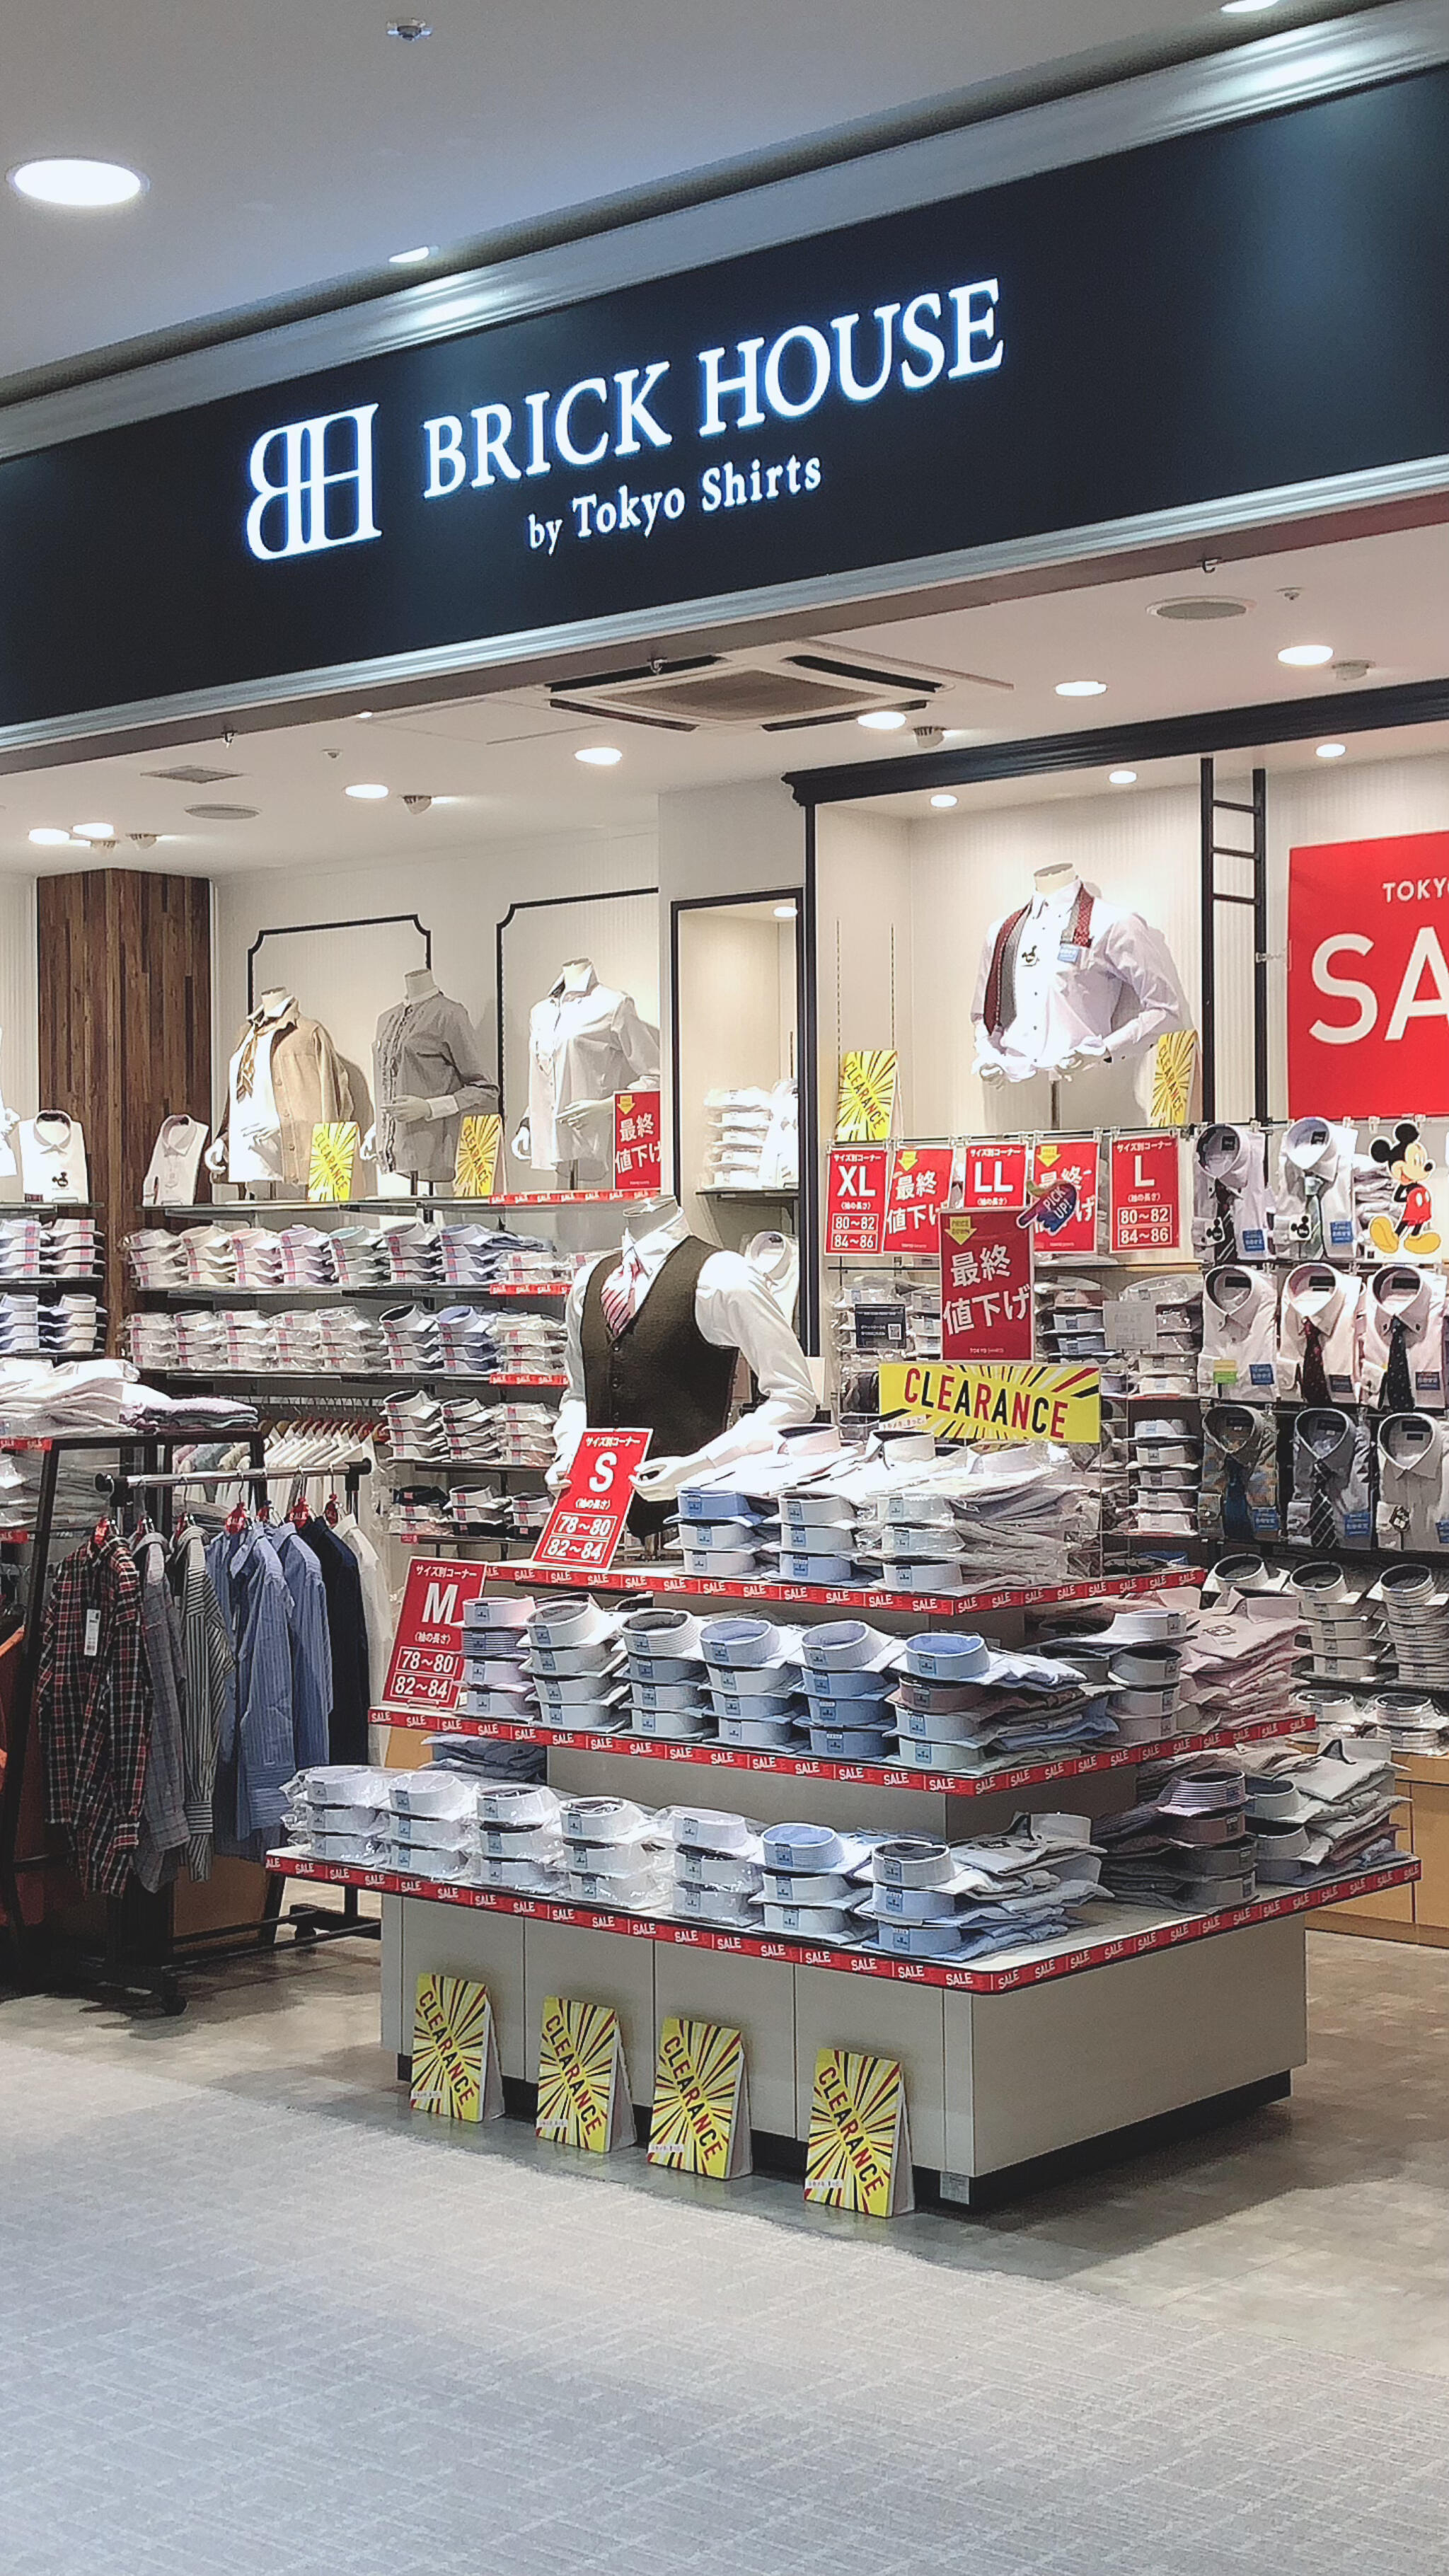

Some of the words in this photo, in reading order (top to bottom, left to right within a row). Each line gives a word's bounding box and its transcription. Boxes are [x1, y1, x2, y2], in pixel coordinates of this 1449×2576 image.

[423, 359, 672, 499] BRICK
[699, 277, 1005, 438] HOUSE
[527, 513, 562, 555] by
[572, 487, 686, 538] Tokyo
[702, 456, 821, 512] Shirts
[1382, 876, 1449, 903] TOKY
[843, 1061, 887, 1131] CLEARANCE
[1157, 1043, 1183, 1119] CLEARANCE
[462, 1124, 488, 1186] CLEARANCE
[620, 1112, 654, 1142] 最終
[313, 1132, 349, 1192] CLEARANCE
[837, 1165, 876, 1196] XL
[895, 1170, 937, 1200] 最終
[974, 1160, 1013, 1193] LL
[1135, 1155, 1155, 1187] L
[1042, 1185, 1067, 1211] PICK
[1053, 1199, 1073, 1220] UP!
[950, 1244, 1011, 1288] 最終
[942, 1283, 1031, 1336] 値下げ
[904, 1366, 1068, 1439] CLEARANCE
[589, 1451, 618, 1493] S
[416, 1564, 478, 1579] サイズ別コーナー
[487, 1566, 499, 1576] LE
[514, 1569, 534, 1581] SALE
[551, 1571, 572, 1583] SALE
[588, 1574, 608, 1585] SALE
[625, 1576, 647, 1588] SALE
[664, 1579, 686, 1590] SALE
[703, 1581, 724, 1594] SALE
[744, 1584, 766, 1597] SALE
[784, 1587, 807, 1600] SALE
[826, 1590, 850, 1603] SALE
[868, 1594, 893, 1607] SALE
[912, 1598, 937, 1611] SALE
[958, 1598, 976, 1613] SALE
[992, 1593, 1011, 1607] SALE
[1024, 1588, 1044, 1602] SALE
[1057, 1585, 1075, 1600] SALE
[1089, 1582, 1107, 1596] SALE
[1119, 1578, 1136, 1593] SALE
[1149, 1575, 1167, 1589] SALE
[1179, 1571, 1196, 1585] SALE
[422, 1582, 459, 1625] M
[371, 1711, 391, 1722] SALE
[406, 1715, 426, 1726] SALE
[441, 1719, 462, 1731] SALE
[478, 1723, 498, 1735] SALE
[515, 1728, 536, 1740] SALE
[553, 1733, 574, 1744] SALE
[591, 1738, 612, 1749] SALE
[630, 1743, 652, 1754] SALE
[669, 1747, 692, 1759] SALE
[711, 1752, 734, 1764] SALE
[752, 1757, 775, 1769] SALE
[795, 1762, 819, 1774] SALE
[839, 1767, 864, 1780] SALE
[884, 1772, 909, 1785] SALE
[930, 1777, 955, 1791] SALE
[976, 1776, 995, 1794] SALE
[1011, 1769, 1030, 1787] SALE
[1045, 1762, 1064, 1780] SALE
[1078, 1755, 1097, 1773] SALE
[1111, 1749, 1129, 1766] SALE
[1142, 1744, 1160, 1760] SALE
[1174, 1738, 1191, 1753] SALE
[1203, 1733, 1221, 1748] SALE
[1233, 1728, 1249, 1743] SALE
[1262, 1723, 1278, 1737] SALE
[1290, 1717, 1306, 1732] SALE
[265, 1857, 281, 1869] ALE
[295, 1862, 314, 1873] SALE
[330, 1869, 350, 1879] SALE
[365, 1874, 385, 1885] SALE
[401, 1881, 422, 1892] SALE
[438, 1887, 458, 1899] SALE
[475, 1894, 497, 1905] SALE
[514, 1901, 535, 1913] SALE
[553, 1909, 575, 1920] SALE
[592, 1916, 615, 1927] SALE
[633, 1923, 656, 1935] SALE
[675, 1930, 698, 1943] SALE
[718, 1937, 741, 1949] SALE
[761, 1944, 786, 1956] SALE
[806, 1951, 831, 1963] SALE
[851, 1958, 877, 1971] SALE
[899, 1965, 924, 1978] SALE
[946, 1973, 973, 1986] SALE
[999, 1969, 1019, 1989] SALE
[1035, 1959, 1056, 1979] SALE
[1070, 1950, 1090, 1970] SALE
[1104, 1941, 1124, 1960] SALE
[1138, 1932, 1156, 1951] SALE
[1171, 1924, 1189, 1942] SALE
[1203, 1916, 1220, 1934] SALE
[1233, 1907, 1251, 1925] SALE
[1263, 1900, 1281, 1918] SALE
[1293, 1892, 1310, 1910] SALE
[1322, 1885, 1339, 1902] SALE
[1349, 1877, 1366, 1895] SALE
[1378, 1871, 1394, 1888] SALE
[1404, 1864, 1419, 1882] SALE
[419, 1989, 477, 2108] CLEARANCE
[543, 2014, 603, 2137] CLEARANCE
[664, 2035, 724, 2161] CLEARANCE
[817, 2064, 885, 2197] CLEARANCE
